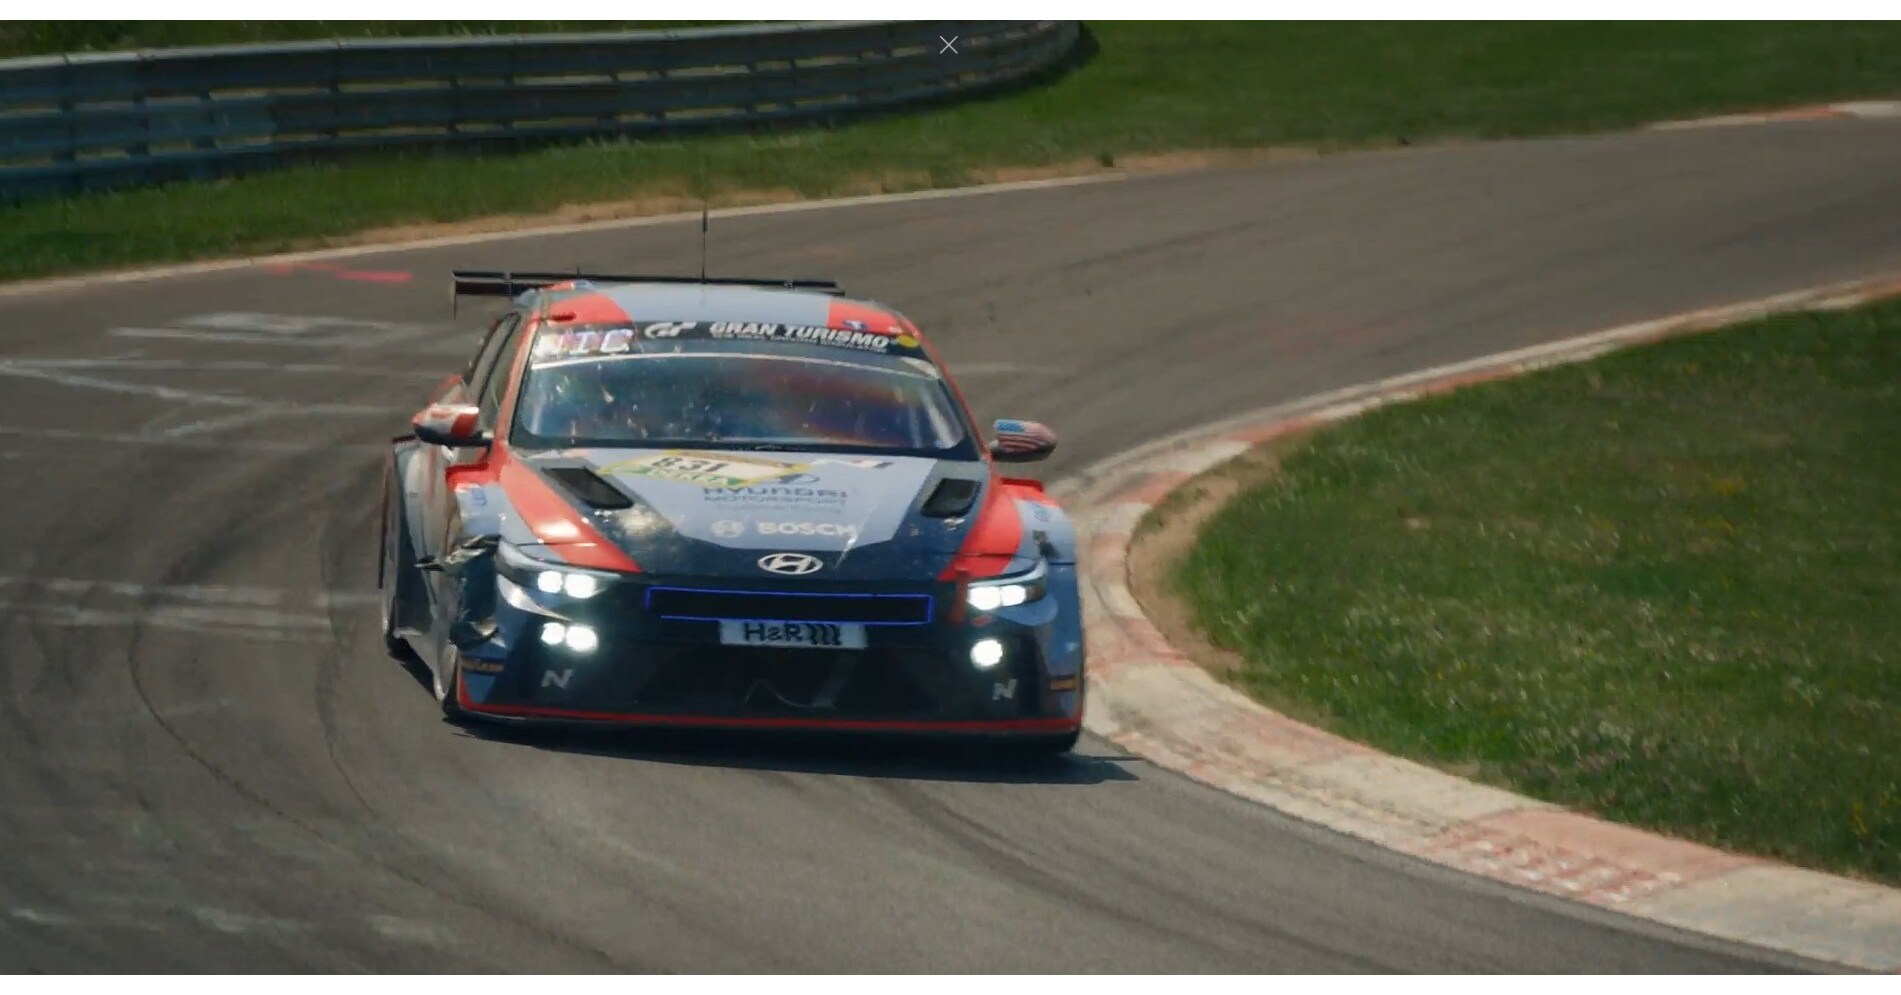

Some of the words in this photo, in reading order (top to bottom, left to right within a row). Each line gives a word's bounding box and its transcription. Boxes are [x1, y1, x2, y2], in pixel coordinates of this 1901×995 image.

[710, 322, 778, 337] GRAN
[784, 326, 890, 349] TURISMO
[652, 456, 729, 472] 831
[757, 521, 857, 536] BOSCH
[541, 668, 574, 689] N
